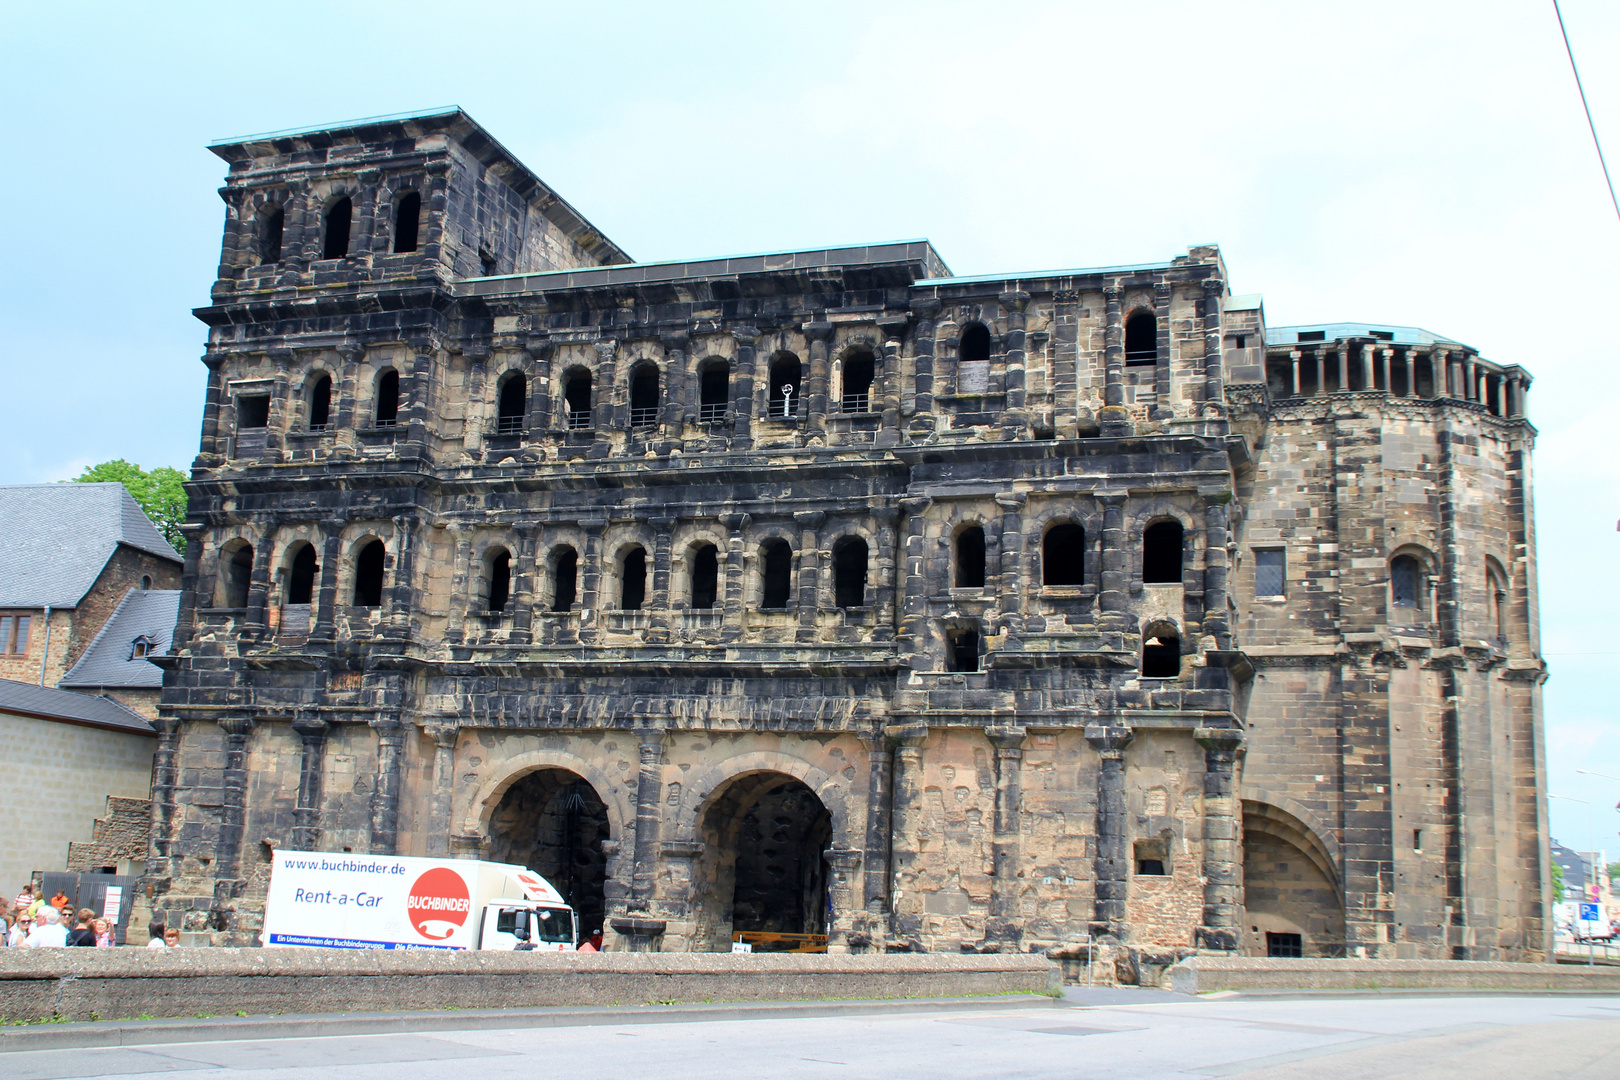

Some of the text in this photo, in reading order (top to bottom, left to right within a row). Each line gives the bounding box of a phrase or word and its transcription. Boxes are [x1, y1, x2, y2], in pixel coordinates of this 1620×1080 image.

[284, 859, 406, 875] www.buchbinder.de
[295, 887, 383, 908] Rent-a-Car
[407, 895, 470, 912] BUCHBINDER
[1581, 905, 1591, 915] P
[276, 934, 386, 950] Ein Unternehmen der Buchbindergruppe
